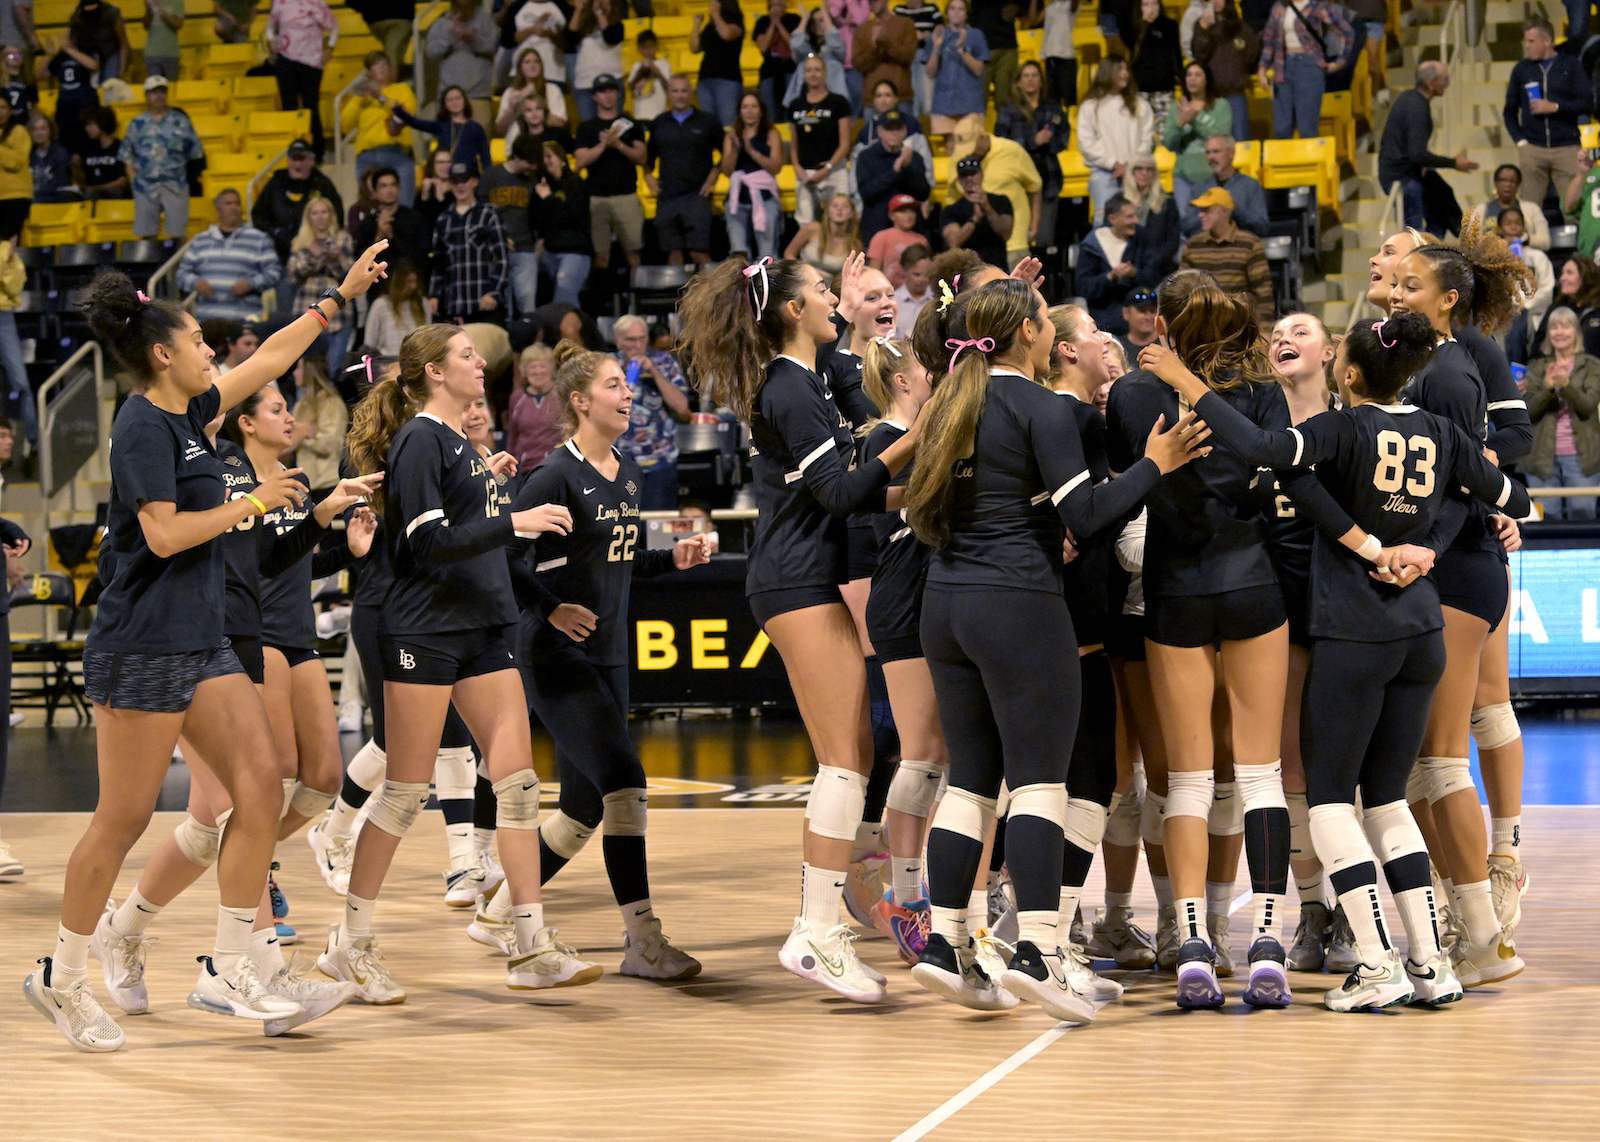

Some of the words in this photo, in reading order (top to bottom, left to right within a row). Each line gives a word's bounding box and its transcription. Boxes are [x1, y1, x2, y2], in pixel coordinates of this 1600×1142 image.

[954, 460, 974, 478] Lee
[1372, 428, 1437, 498] 83
[485, 478, 500, 519] 12
[1380, 492, 1419, 515] Glenn
[595, 503, 620, 522] Long
[607, 523, 639, 562] 22
[399, 648, 416, 670] LB
